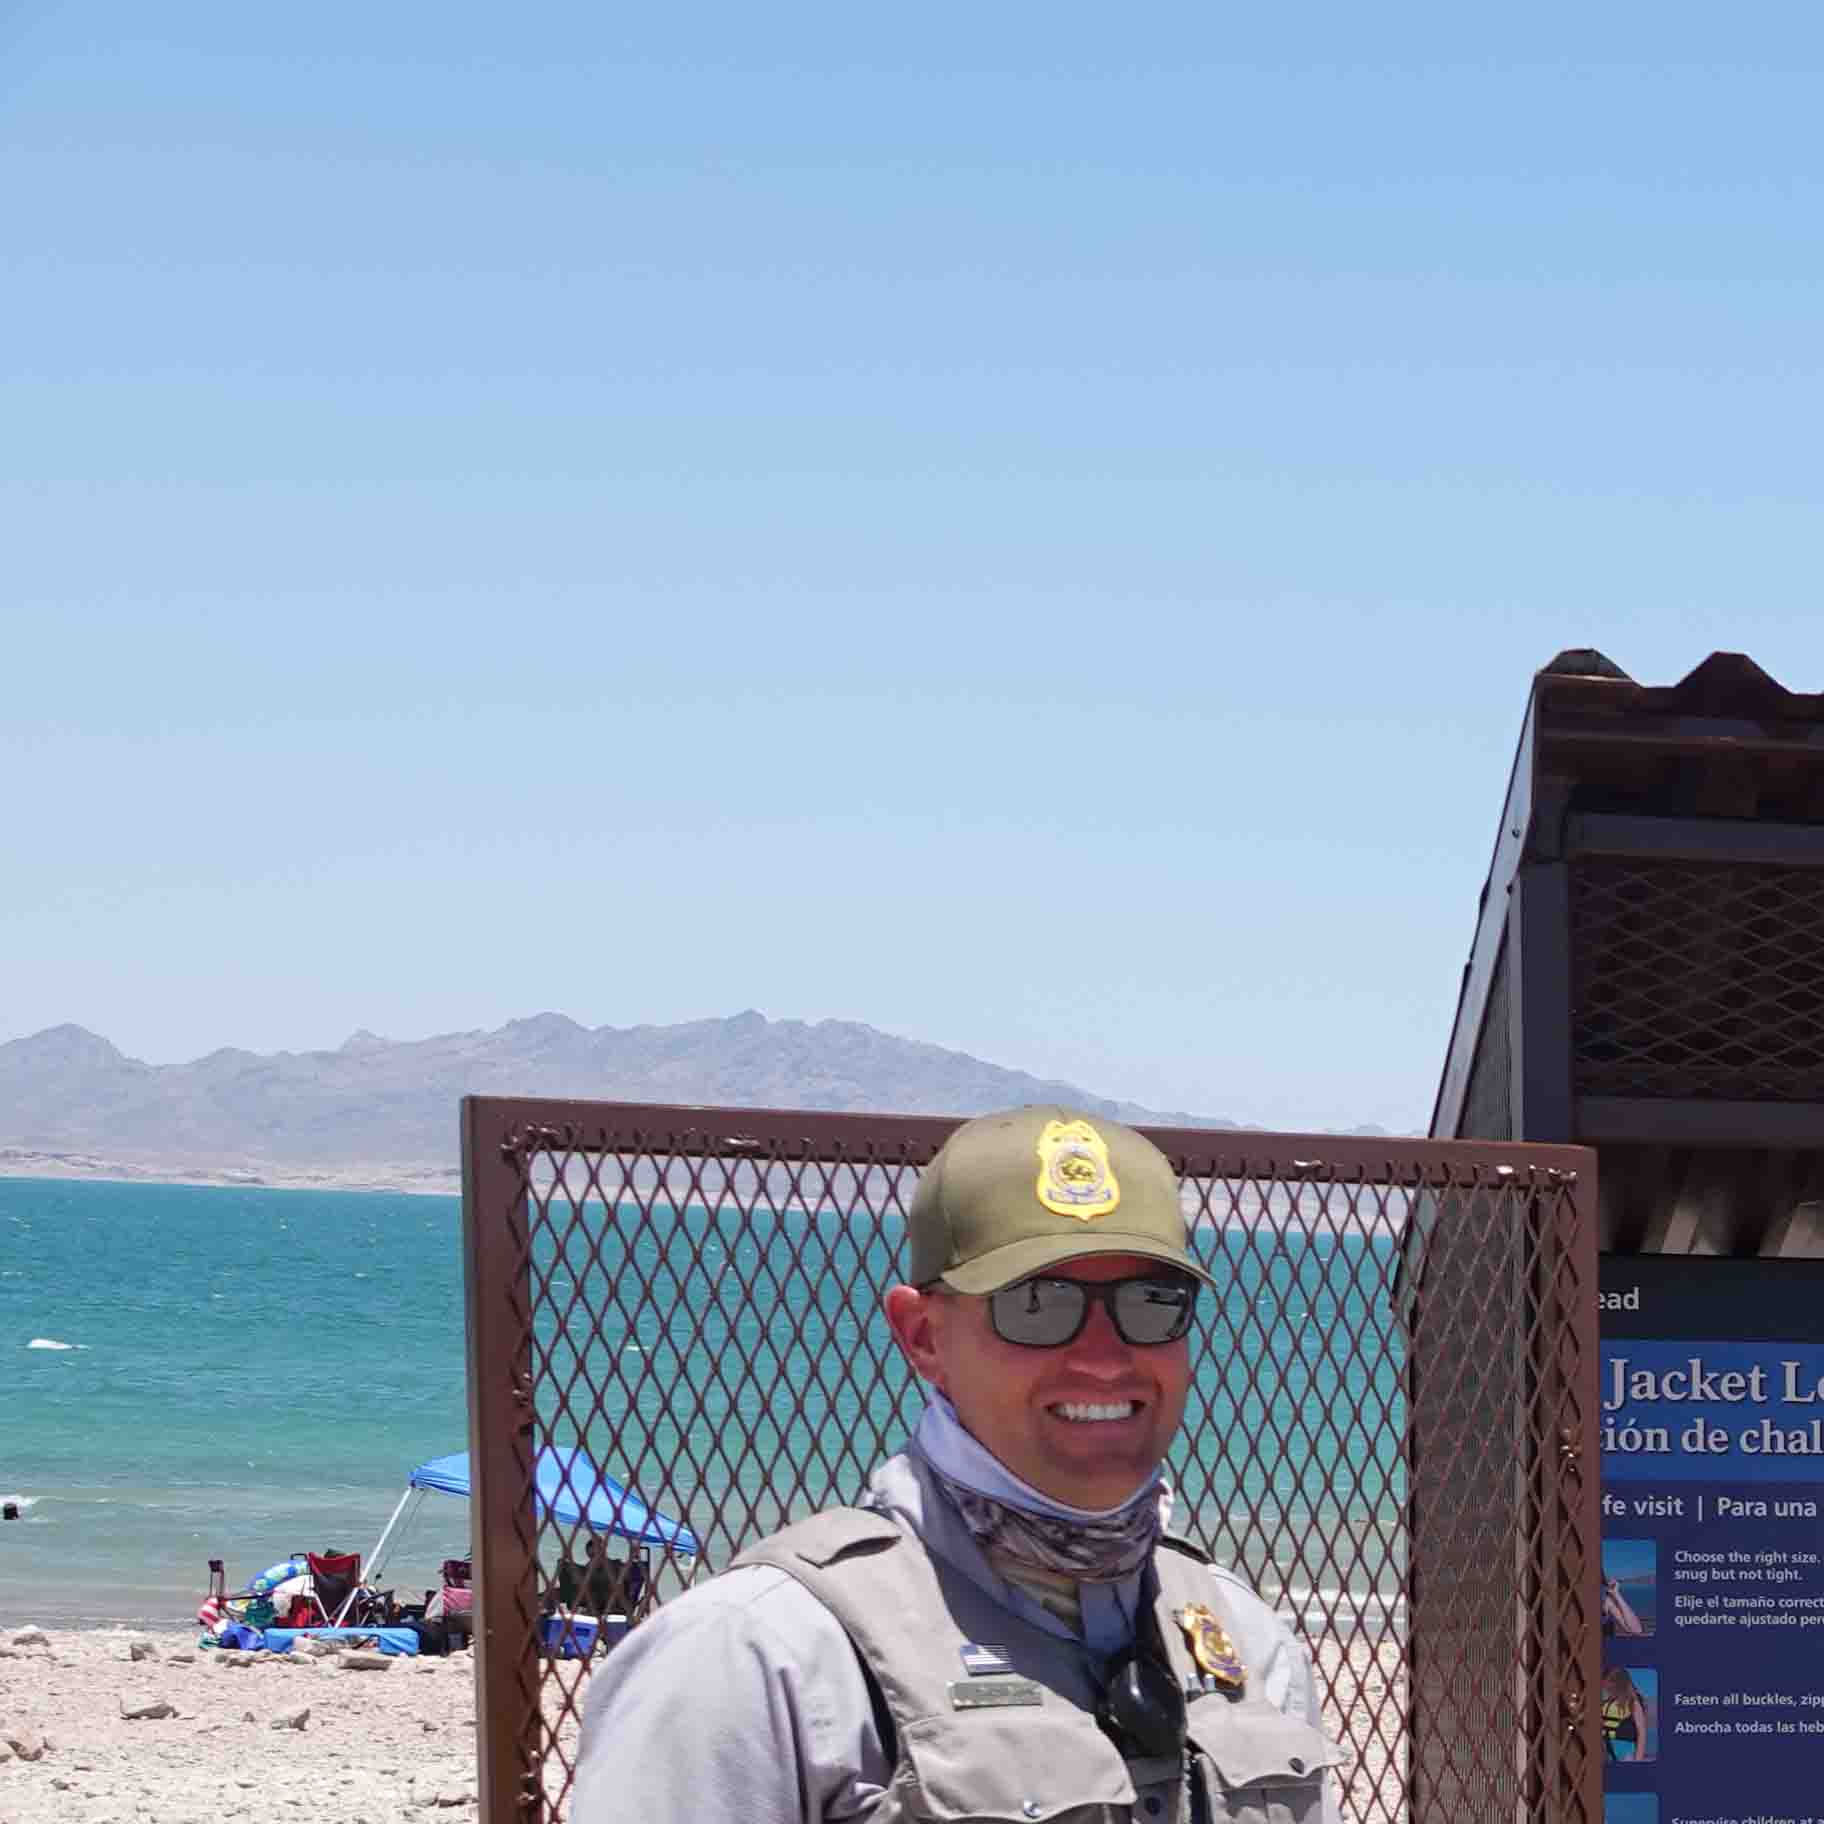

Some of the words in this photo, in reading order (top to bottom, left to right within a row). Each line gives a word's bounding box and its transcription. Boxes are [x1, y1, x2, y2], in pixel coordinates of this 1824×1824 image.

[1598, 1286, 1640, 1310] ead
[1604, 1358, 1767, 1410] Jacket
[1601, 1417, 1671, 1453] ión
[1682, 1418, 1728, 1452] de
[1602, 1494, 1625, 1517] fe
[1634, 1496, 1683, 1515] visit
[1718, 1497, 1767, 1516] Para
[1775, 1502, 1816, 1517] una
[1675, 1551, 1724, 1563] Choose
[1728, 1551, 1750, 1562] the
[1755, 1552, 1787, 1566] right
[1792, 1552, 1820, 1563] size.
[1675, 1571, 1707, 1582] snug
[1712, 1568, 1736, 1580] but
[1739, 1569, 1762, 1580] not
[1766, 1568, 1802, 1583] tight.
[1675, 1596, 1703, 1610] Elije
[1707, 1595, 1719, 1608] el
[1723, 1596, 1775, 1608] tamaño
[1675, 1613, 1736, 1626] quedarte
[1740, 1612, 1796, 1627] ajustado
[1675, 1694, 1718, 1705] Fasten
[1723, 1693, 1738, 1705] all
[1743, 1693, 1797, 1706] buckles,
[1675, 1721, 1731, 1733] Abrocha
[1736, 1721, 1773, 1733] todas
[1777, 1721, 1795, 1733] las
